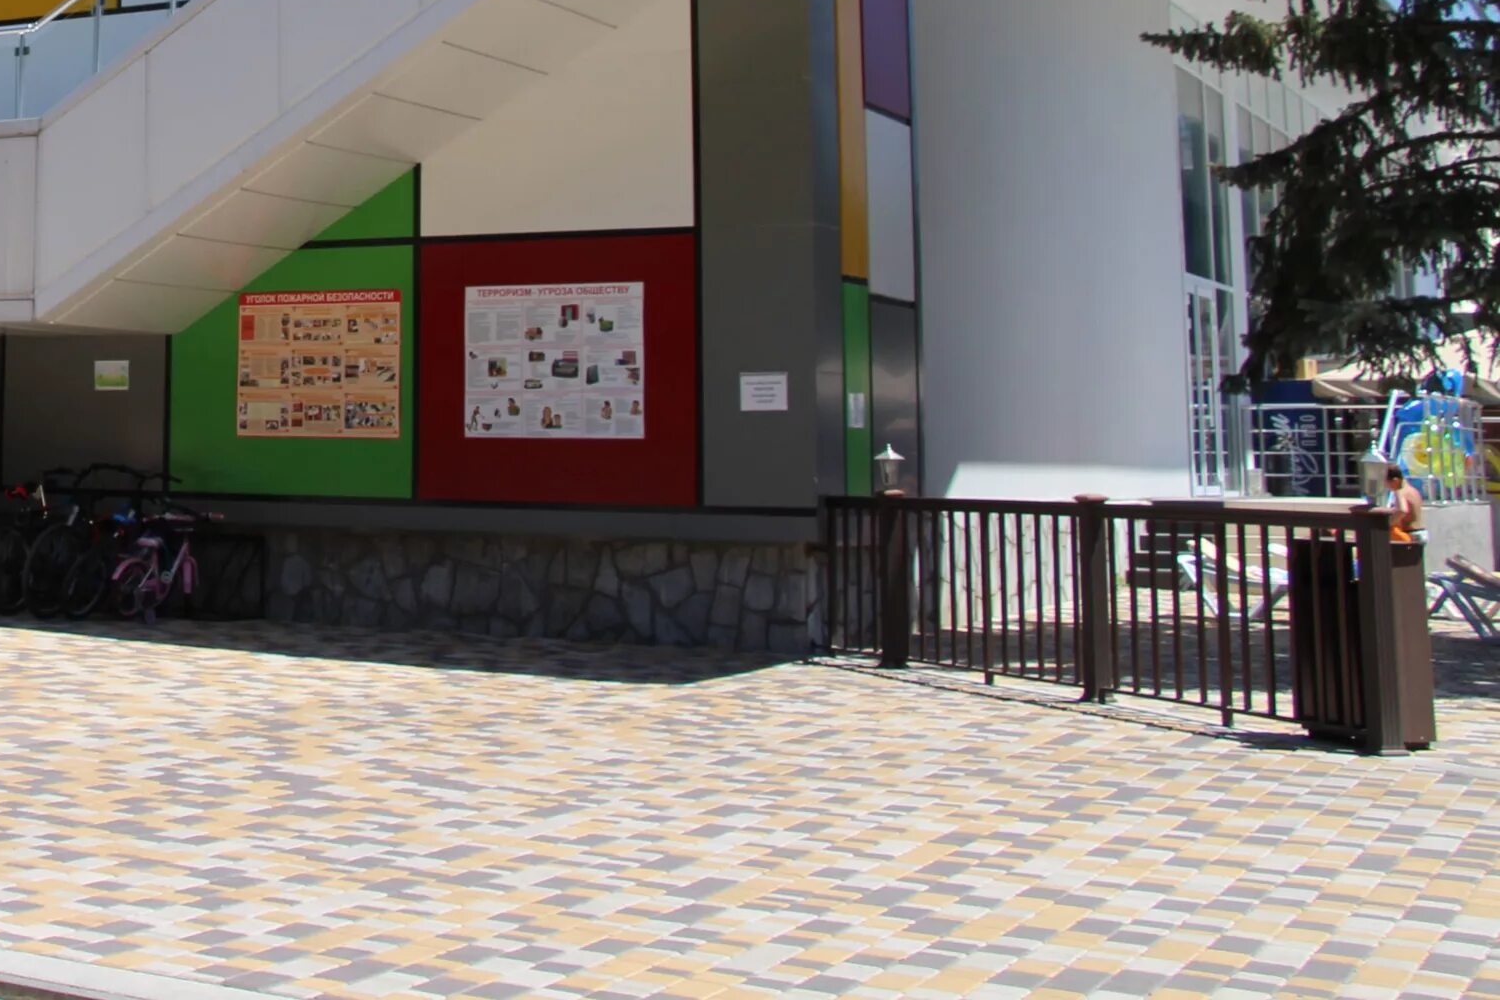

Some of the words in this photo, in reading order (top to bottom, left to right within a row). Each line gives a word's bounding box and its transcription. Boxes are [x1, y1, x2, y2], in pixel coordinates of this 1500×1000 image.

[246, 294, 276, 304] УГОЛОК
[277, 292, 324, 303] ПОЖАРНОЙ
[327, 291, 394, 302] БЕЗОПАСНОСТИ
[477, 288, 532, 297] ТЕРРОРИЗМ
[538, 287, 574, 296] УГРОЗА
[576, 286, 629, 295] ОБЩЕСТВУ
